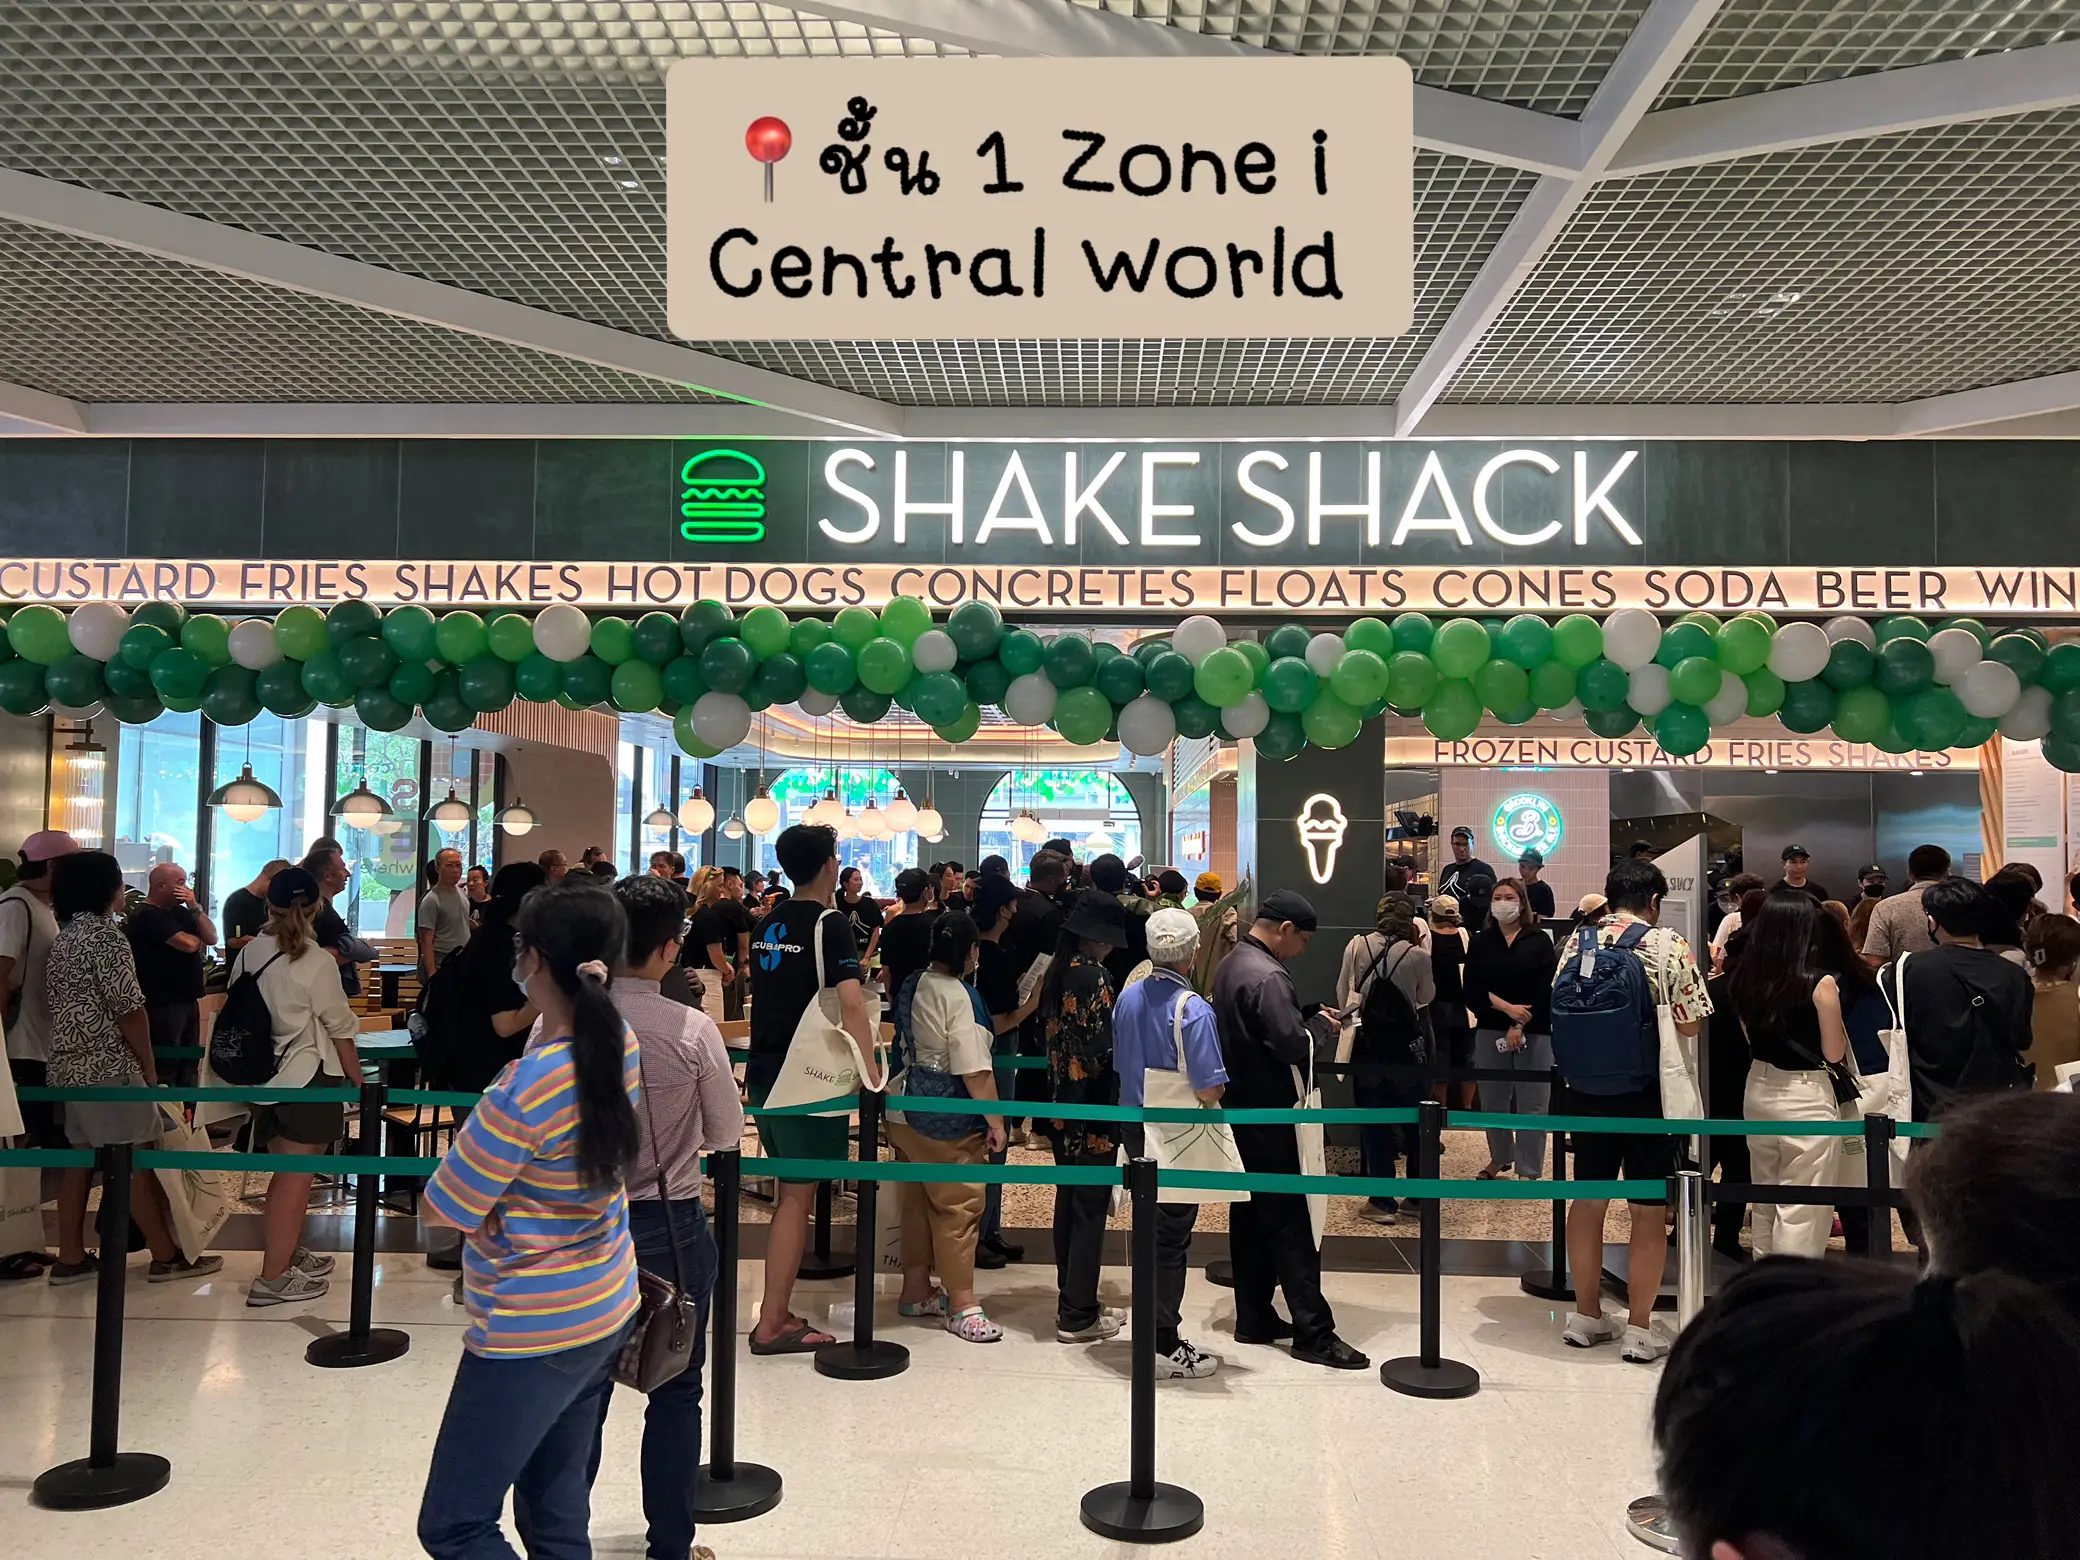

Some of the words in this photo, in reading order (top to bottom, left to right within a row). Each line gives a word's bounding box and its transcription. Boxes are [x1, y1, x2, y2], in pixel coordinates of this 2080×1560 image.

[817, 448, 1201, 547] SHAKE
[1231, 448, 1643, 547] SHACK
[0, 561, 215, 599] CUSTARD
[239, 563, 368, 600] FRIES
[394, 564, 581, 601] SHAKES
[608, 565, 711, 604] HOT
[725, 566, 866, 605] DOGS
[891, 567, 1195, 607] CONCRETES
[1220, 569, 1408, 607] FLOATS
[1433, 569, 1617, 608] CONES
[1644, 570, 1788, 608] SODA
[1816, 571, 1947, 608] BEER
[1976, 571, 2077, 609] WIN
[1434, 740, 1557, 763] FROZEN
[1570, 741, 1713, 766] CUSTAD
[1729, 742, 1811, 766] FRIES
[804, 1066, 836, 1083] SHAKE
